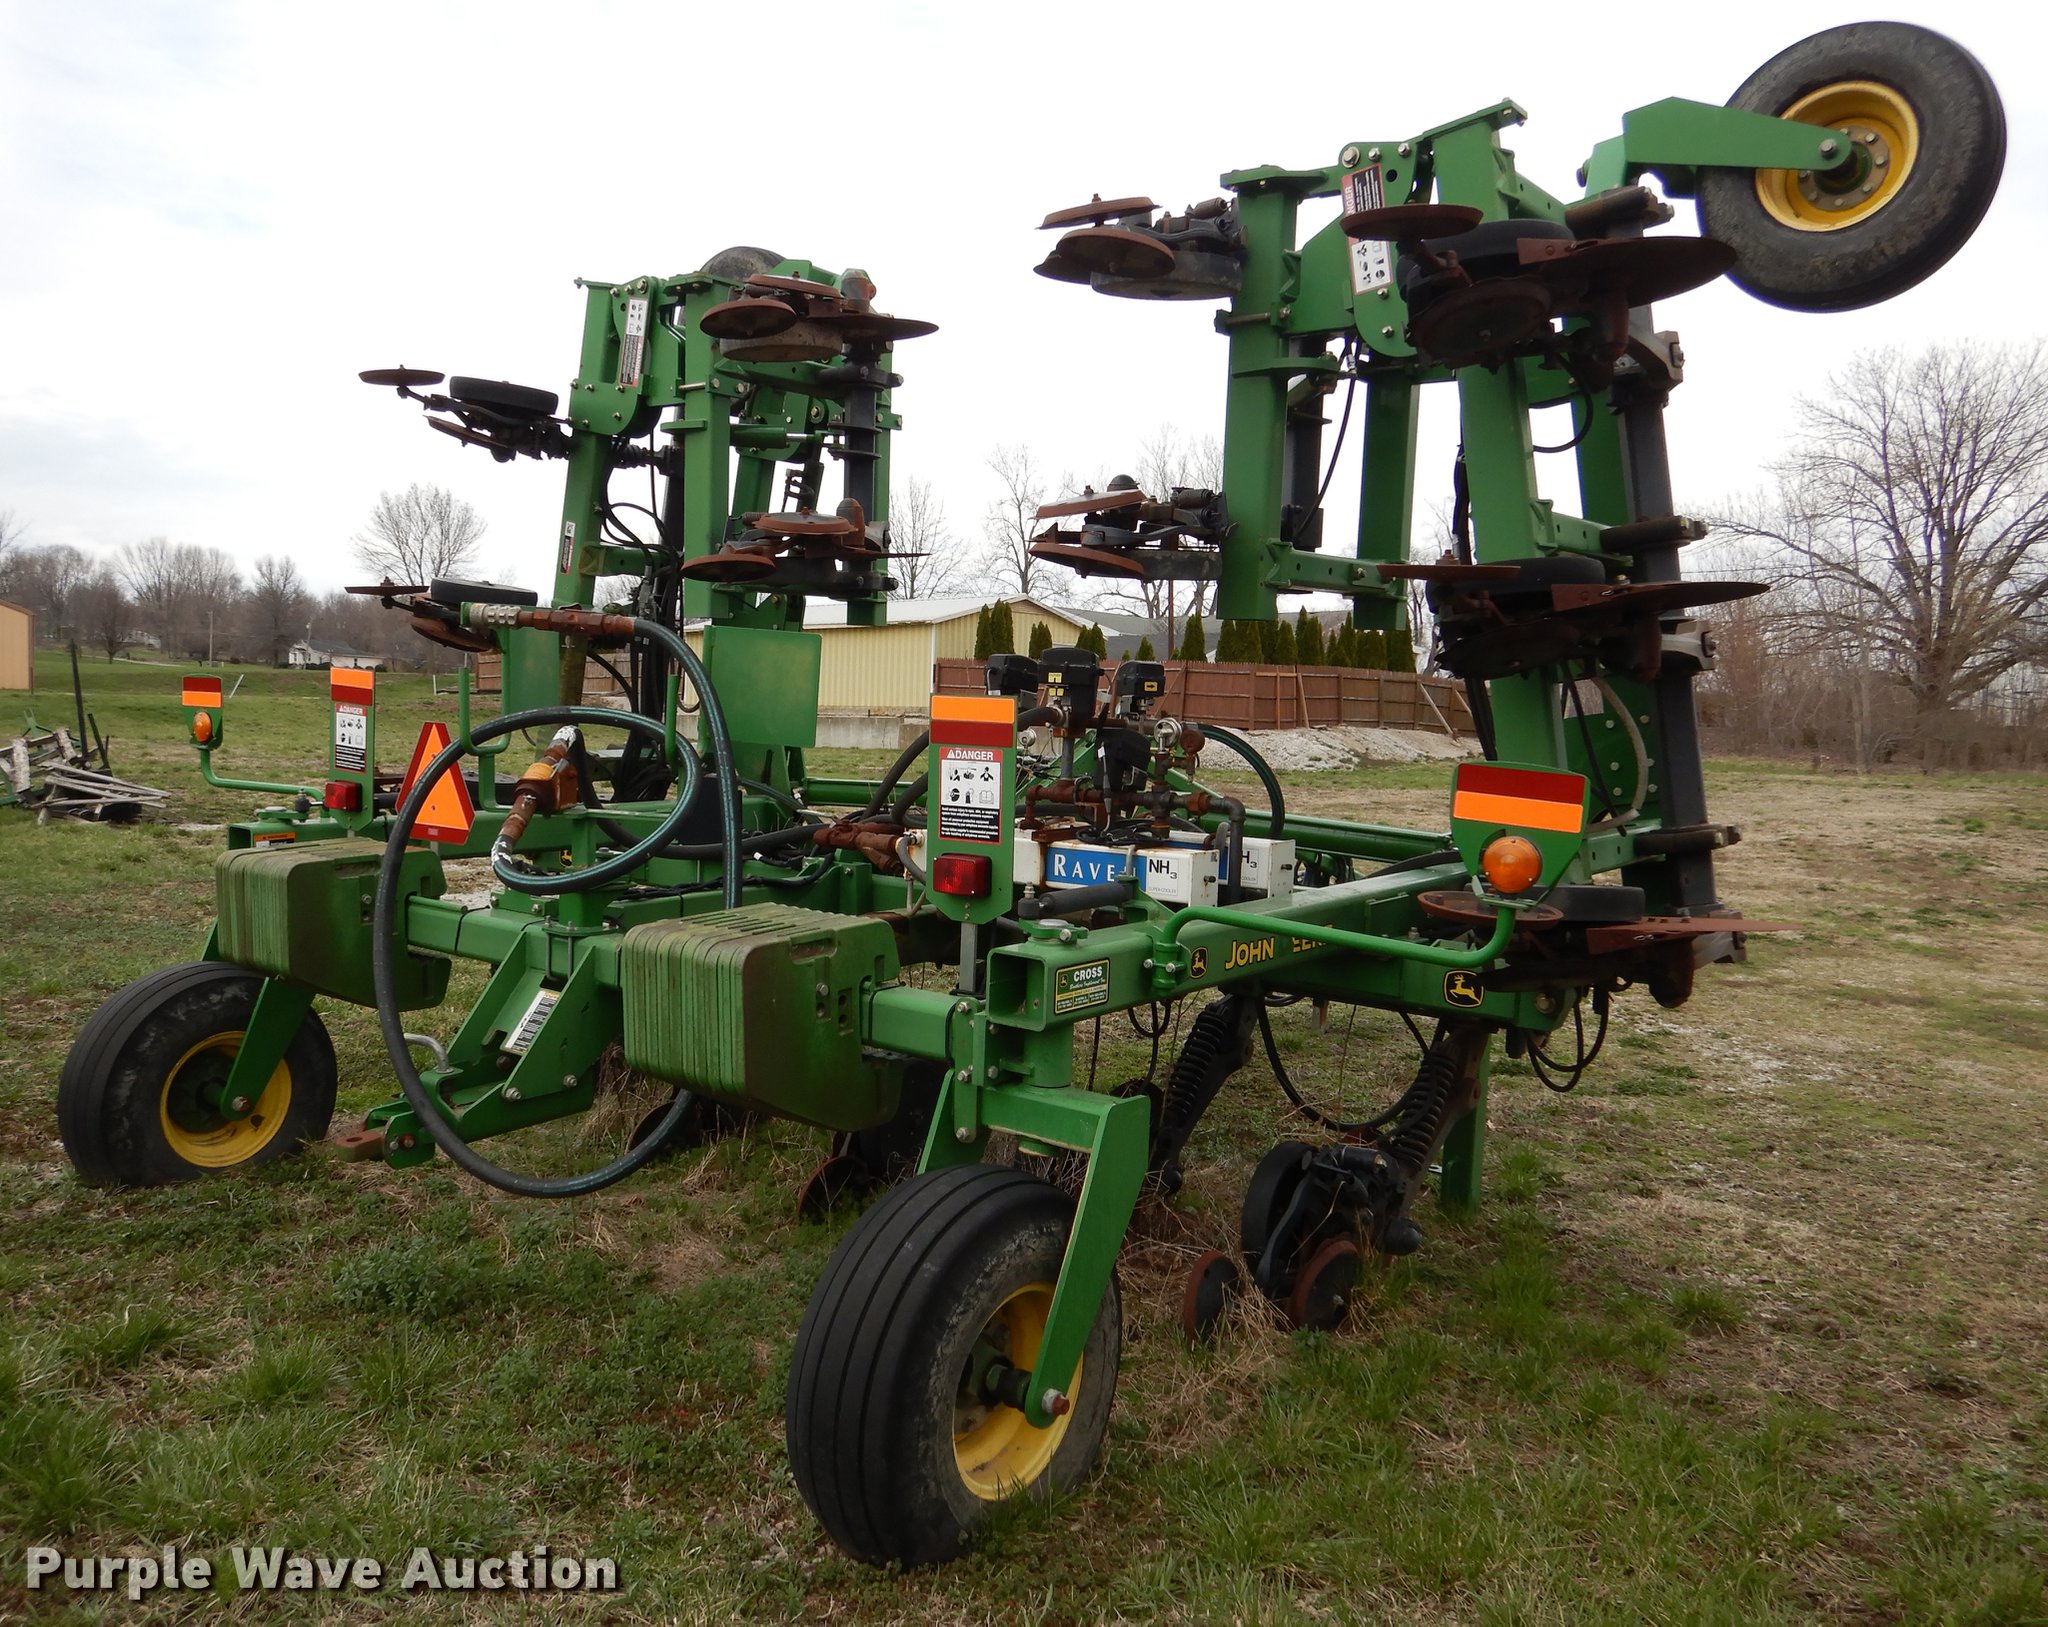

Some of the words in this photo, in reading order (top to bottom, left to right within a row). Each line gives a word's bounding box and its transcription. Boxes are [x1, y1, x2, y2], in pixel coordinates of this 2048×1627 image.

[955, 749, 994, 761] DANGER
[1225, 937, 1275, 970] JOHN
[1073, 966, 1103, 982] CROSS
